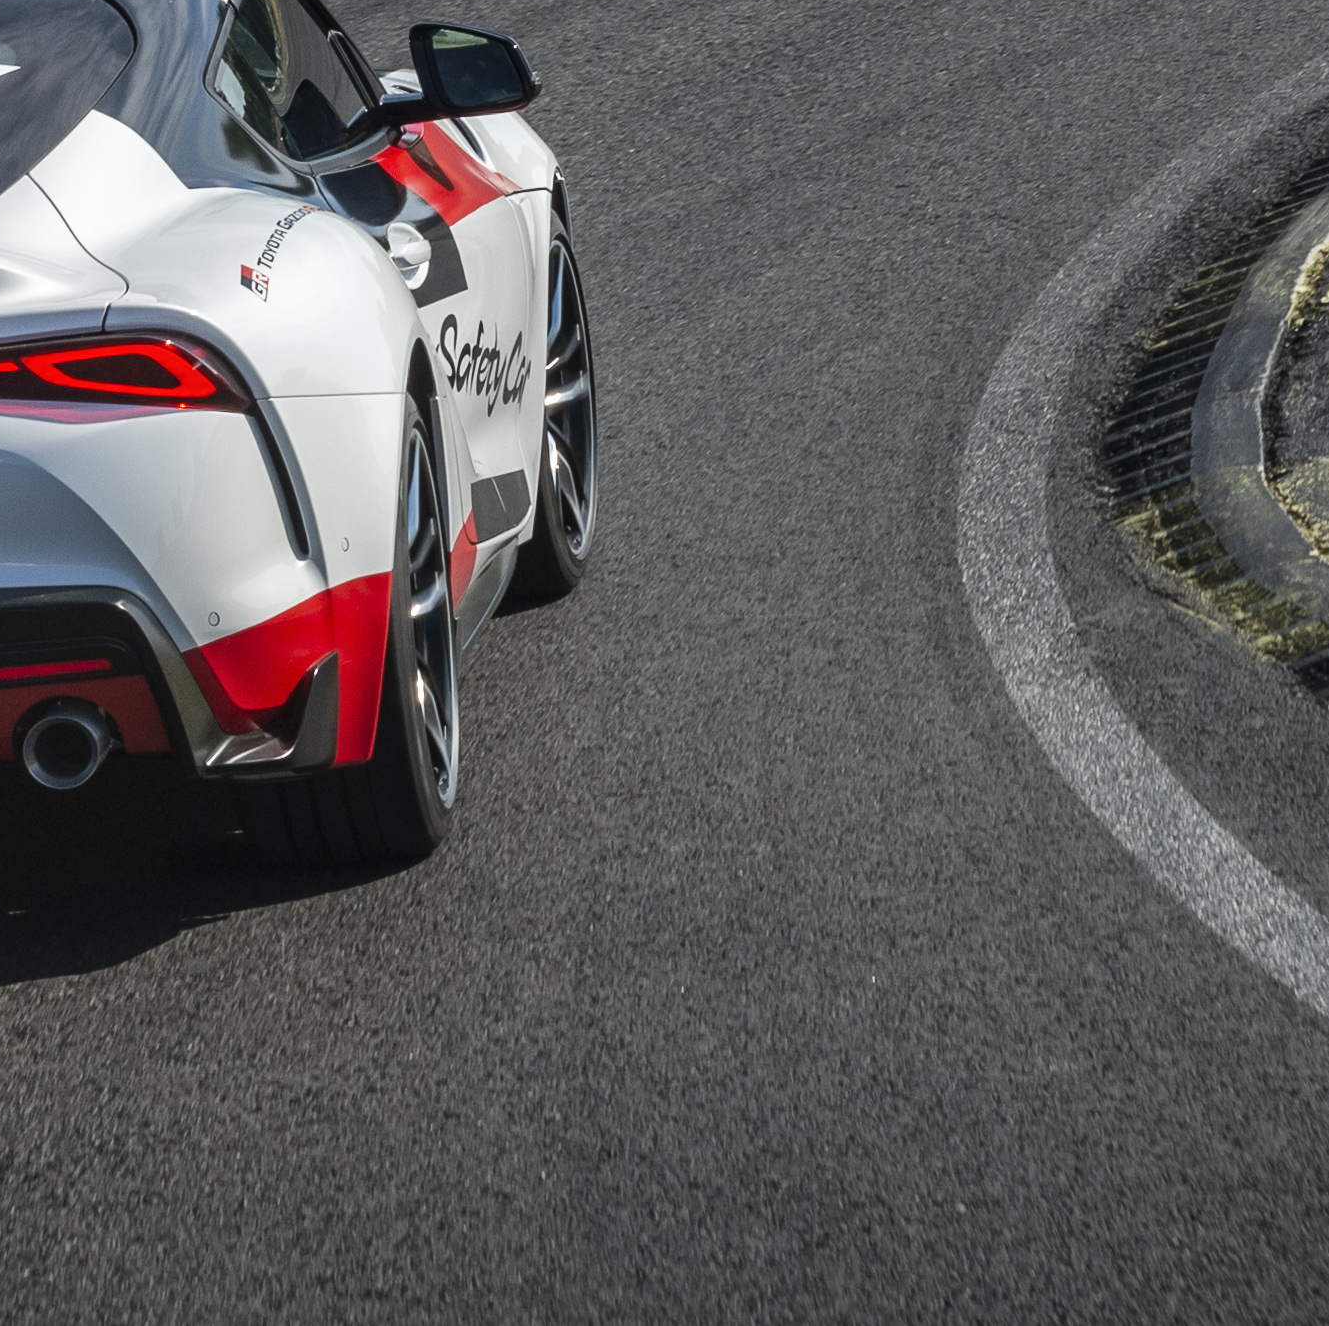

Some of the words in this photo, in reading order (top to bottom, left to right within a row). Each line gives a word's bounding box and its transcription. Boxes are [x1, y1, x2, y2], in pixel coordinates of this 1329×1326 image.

[257, 228, 288, 269] TOYOTA
[436, 314, 507, 417] Safety
[502, 331, 531, 414] Car
